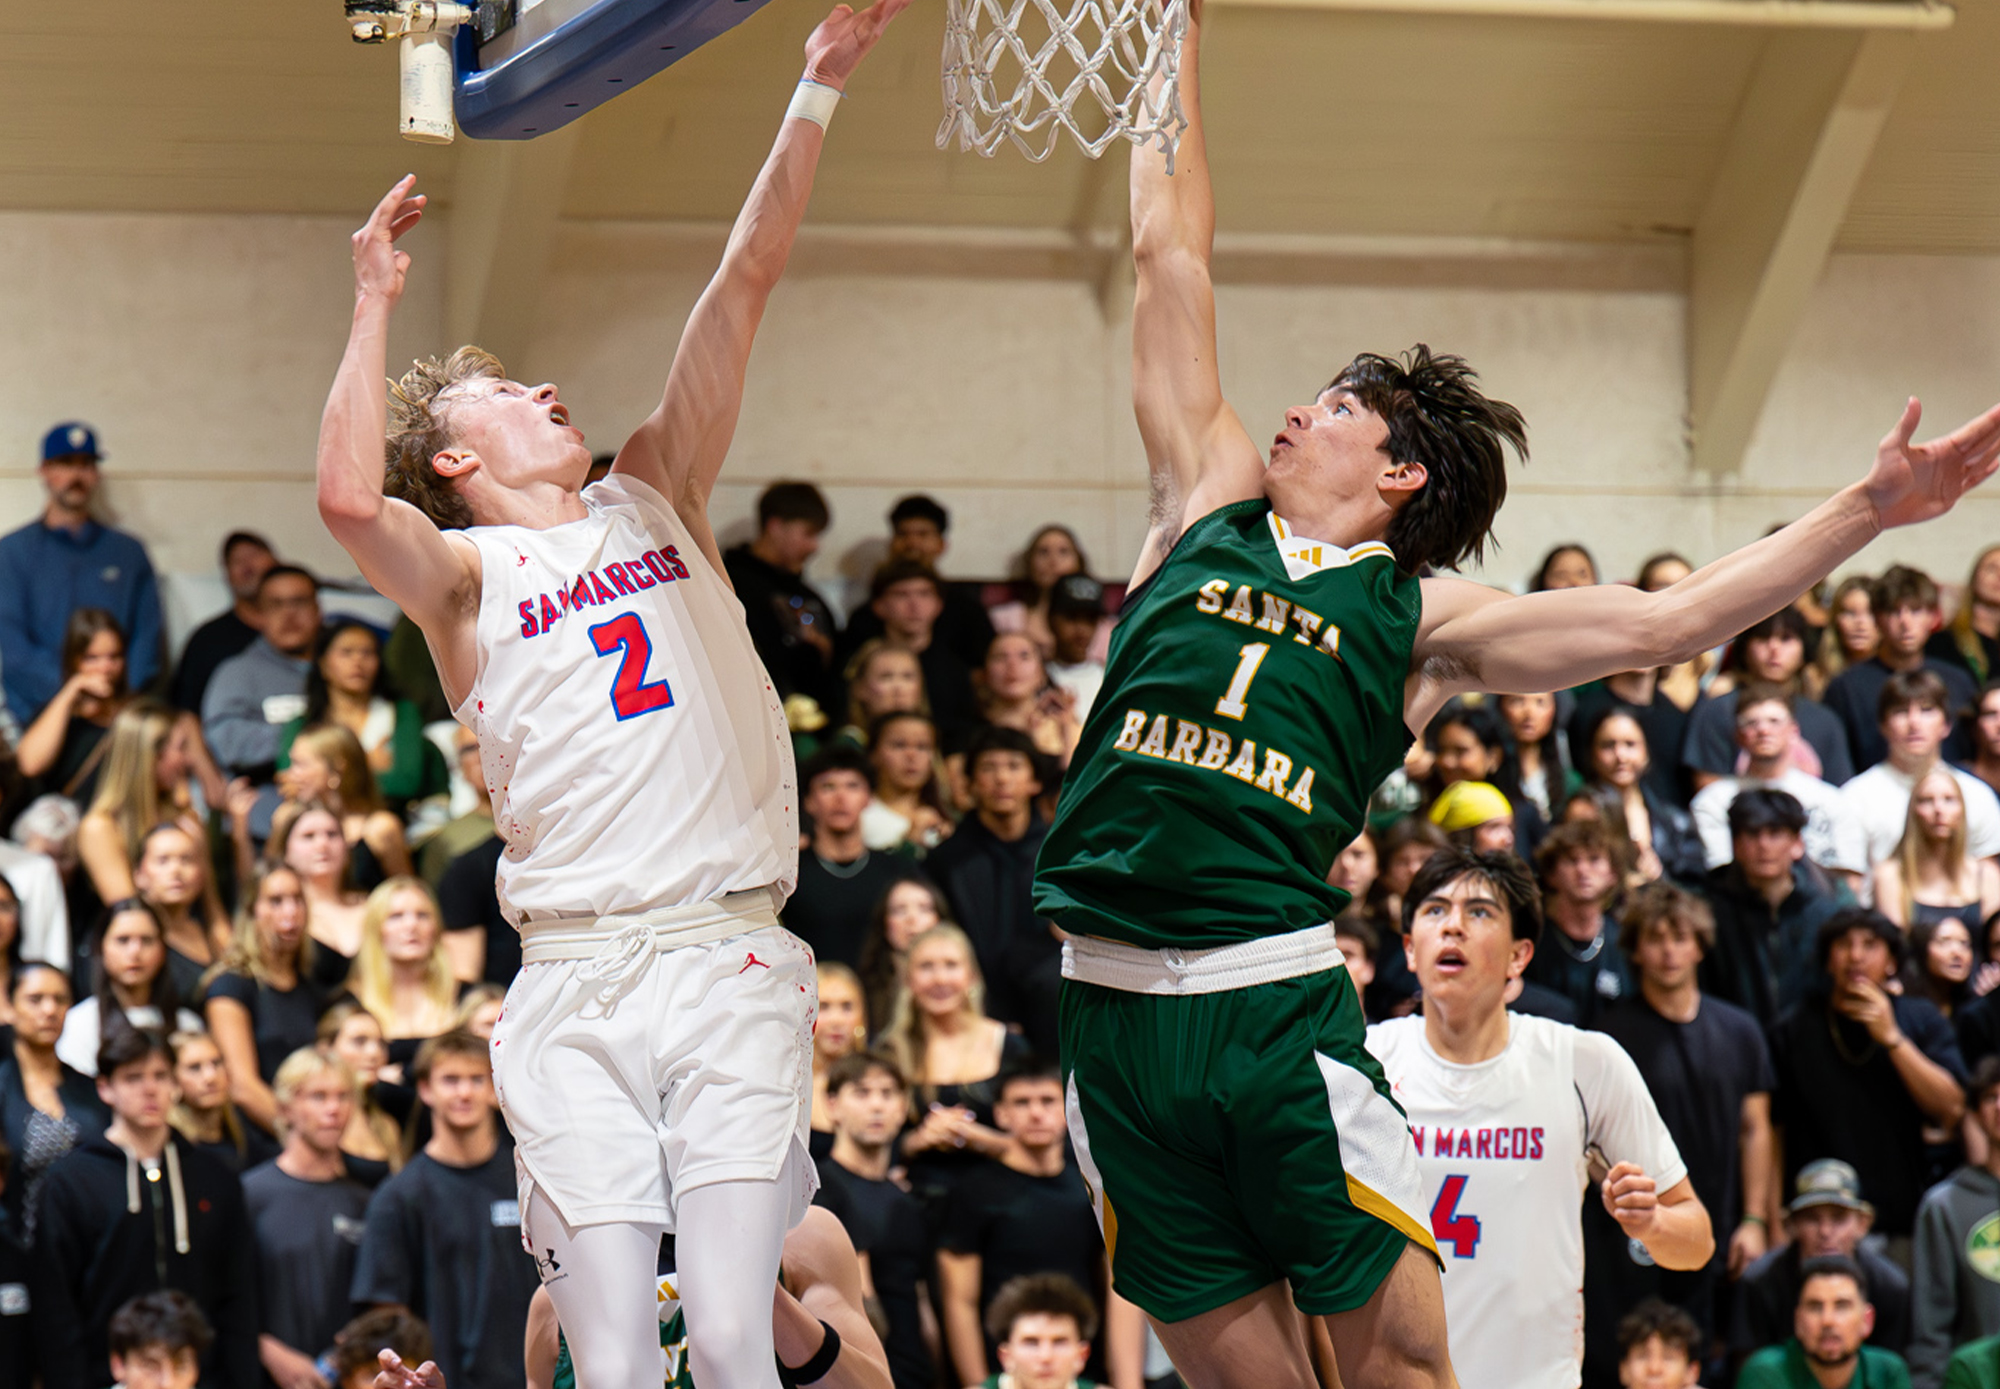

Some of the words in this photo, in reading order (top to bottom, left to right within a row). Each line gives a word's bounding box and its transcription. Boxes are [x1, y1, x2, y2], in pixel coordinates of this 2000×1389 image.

[570, 544, 691, 612] MARCOS
[1196, 579, 1343, 663] SANTA
[587, 611, 675, 722] 2
[1214, 642, 1271, 721] 1
[1113, 708, 1316, 815] BARBARA
[1434, 1127, 1545, 1160] MARCOS
[1429, 1174, 1482, 1260] 4
